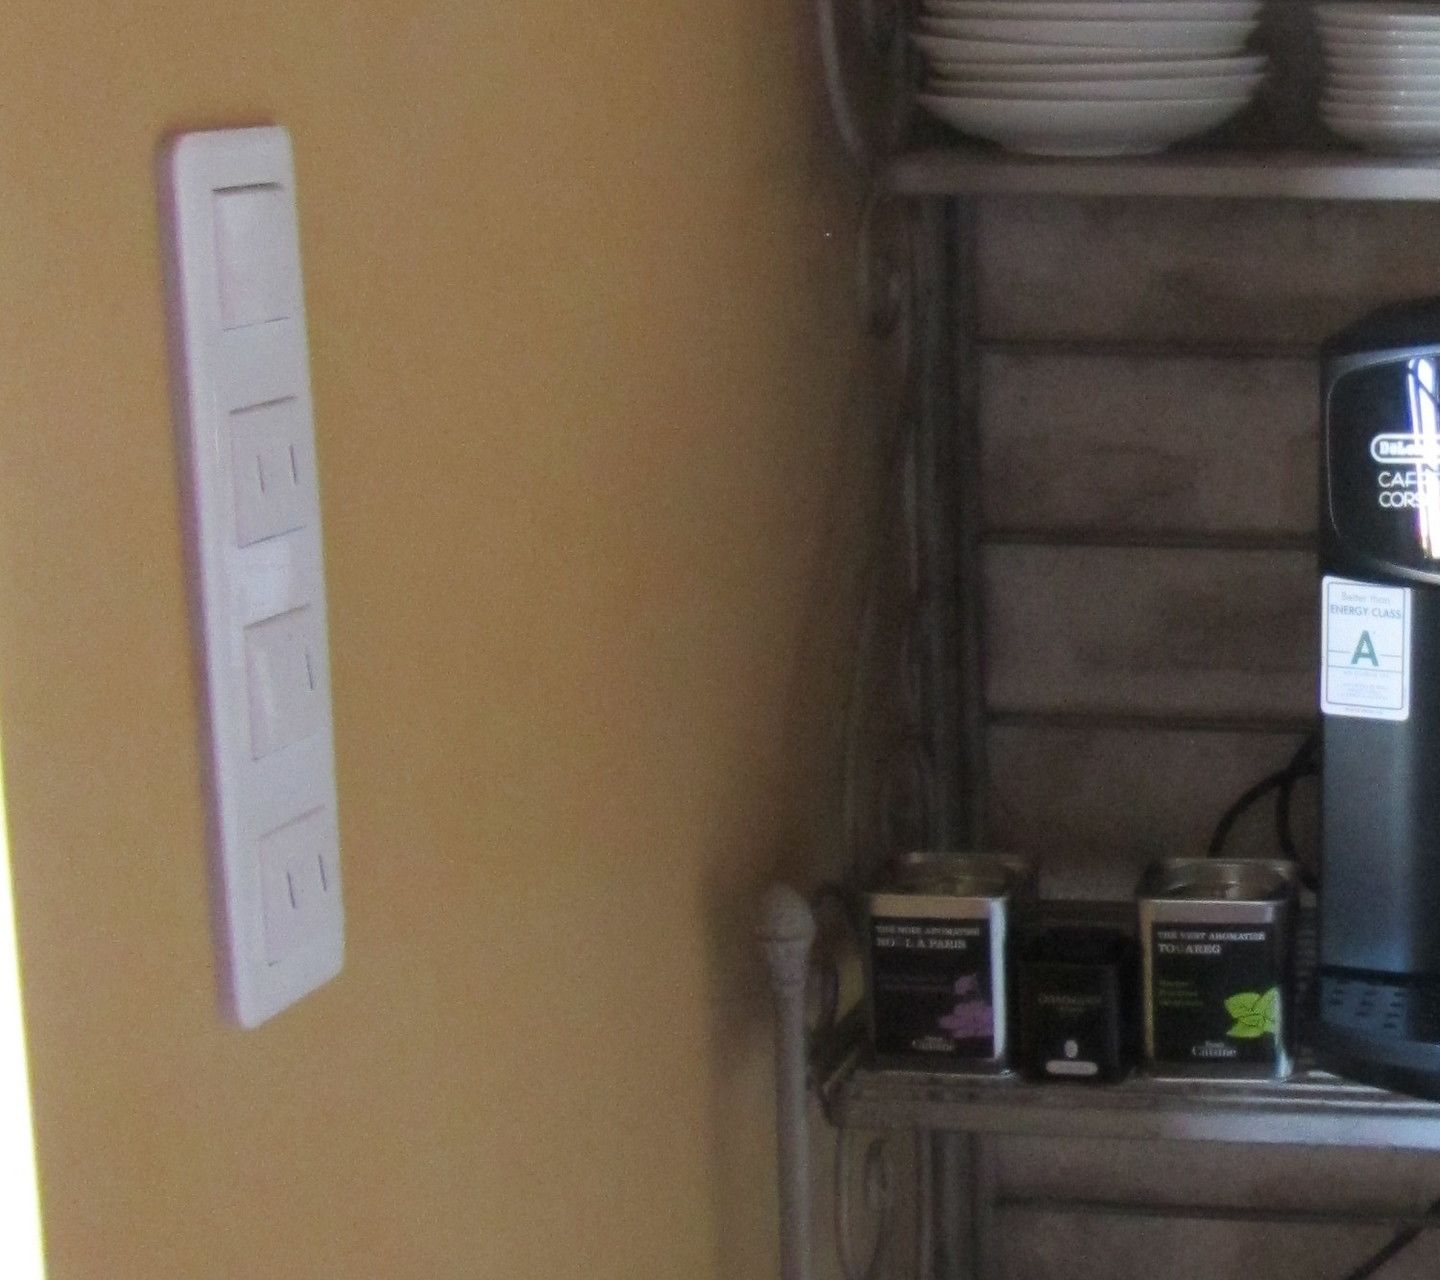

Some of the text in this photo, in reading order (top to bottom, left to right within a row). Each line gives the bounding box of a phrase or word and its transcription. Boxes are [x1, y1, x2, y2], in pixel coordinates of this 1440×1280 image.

[1330, 604, 1402, 619] ENERGY CLASS
[1350, 629, 1379, 667] A
